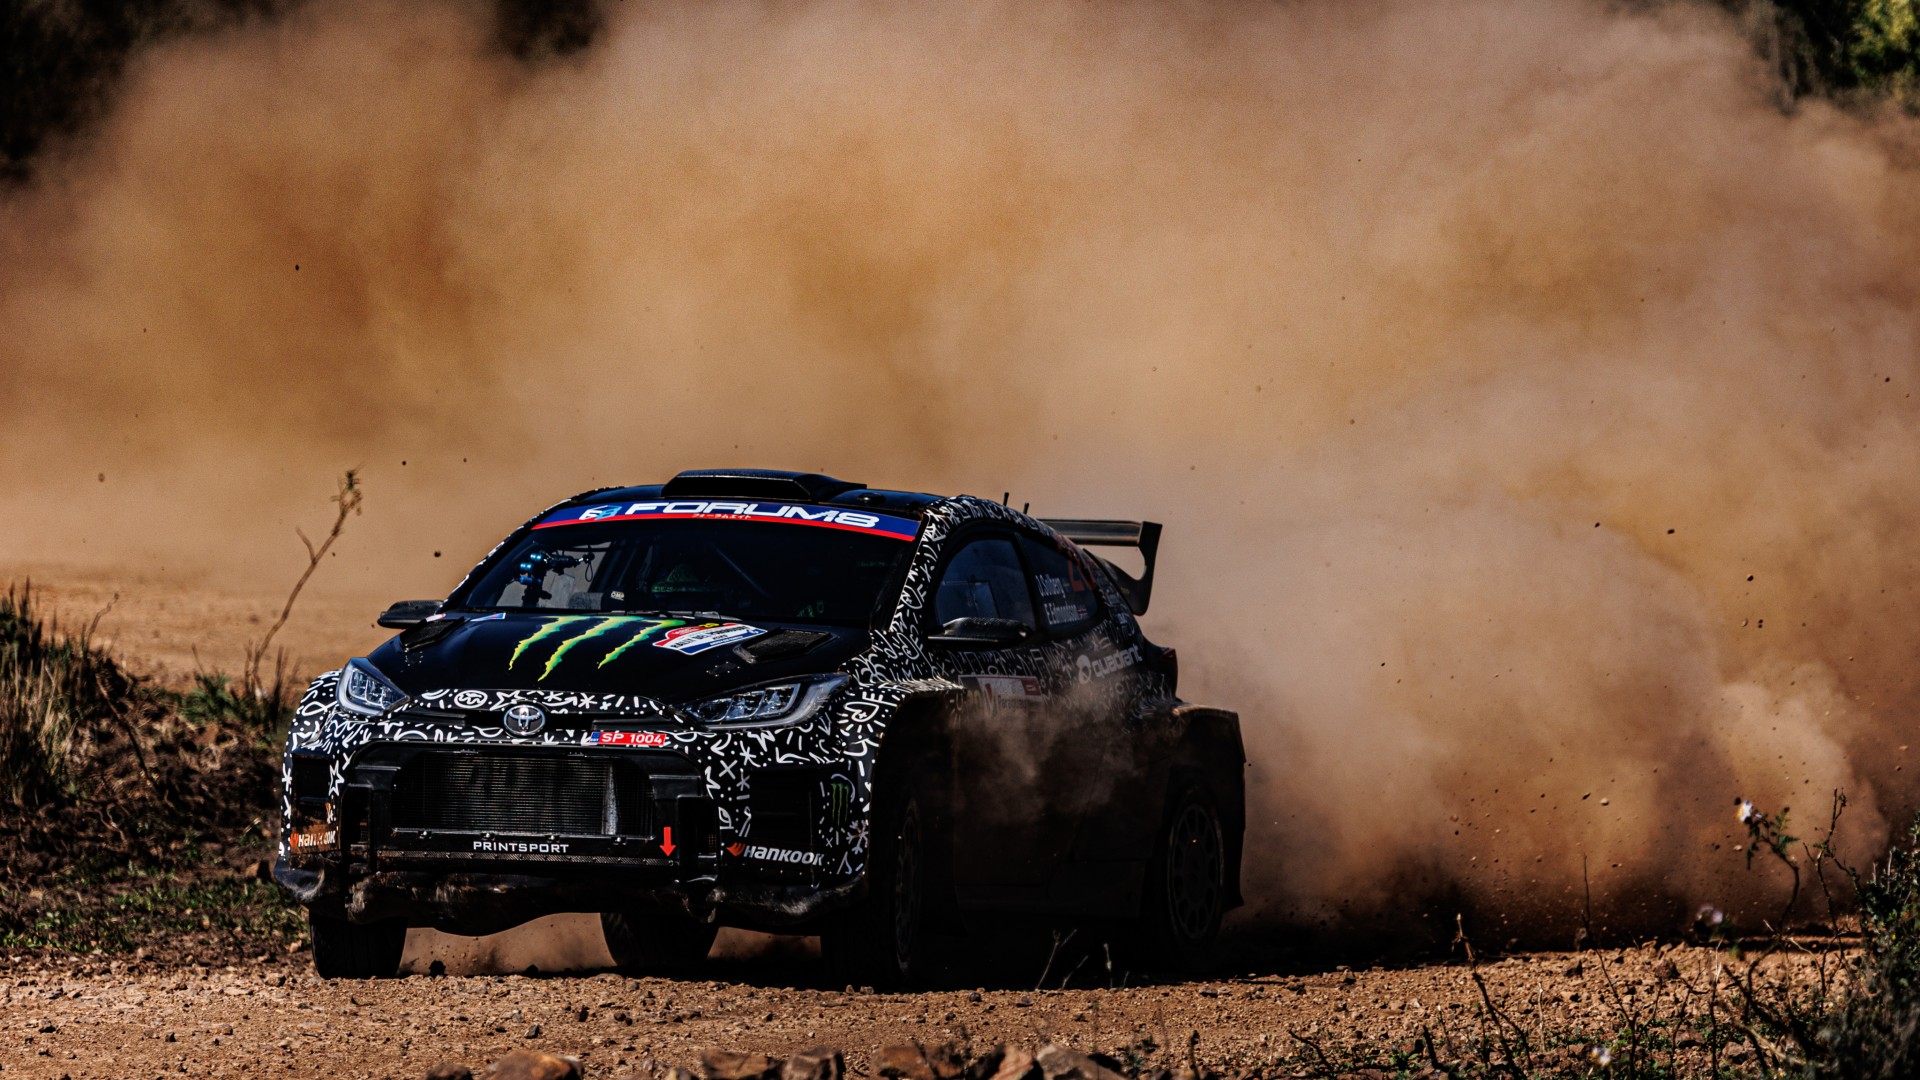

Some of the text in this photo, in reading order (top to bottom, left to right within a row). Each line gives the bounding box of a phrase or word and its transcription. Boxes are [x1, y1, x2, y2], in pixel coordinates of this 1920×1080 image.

[624, 502, 880, 528] FORUM8
[1091, 644, 1143, 677] quadrant
[601, 733, 625, 743] SP
[630, 734, 663, 744] 1004
[473, 841, 569, 853] PRINTSPORT
